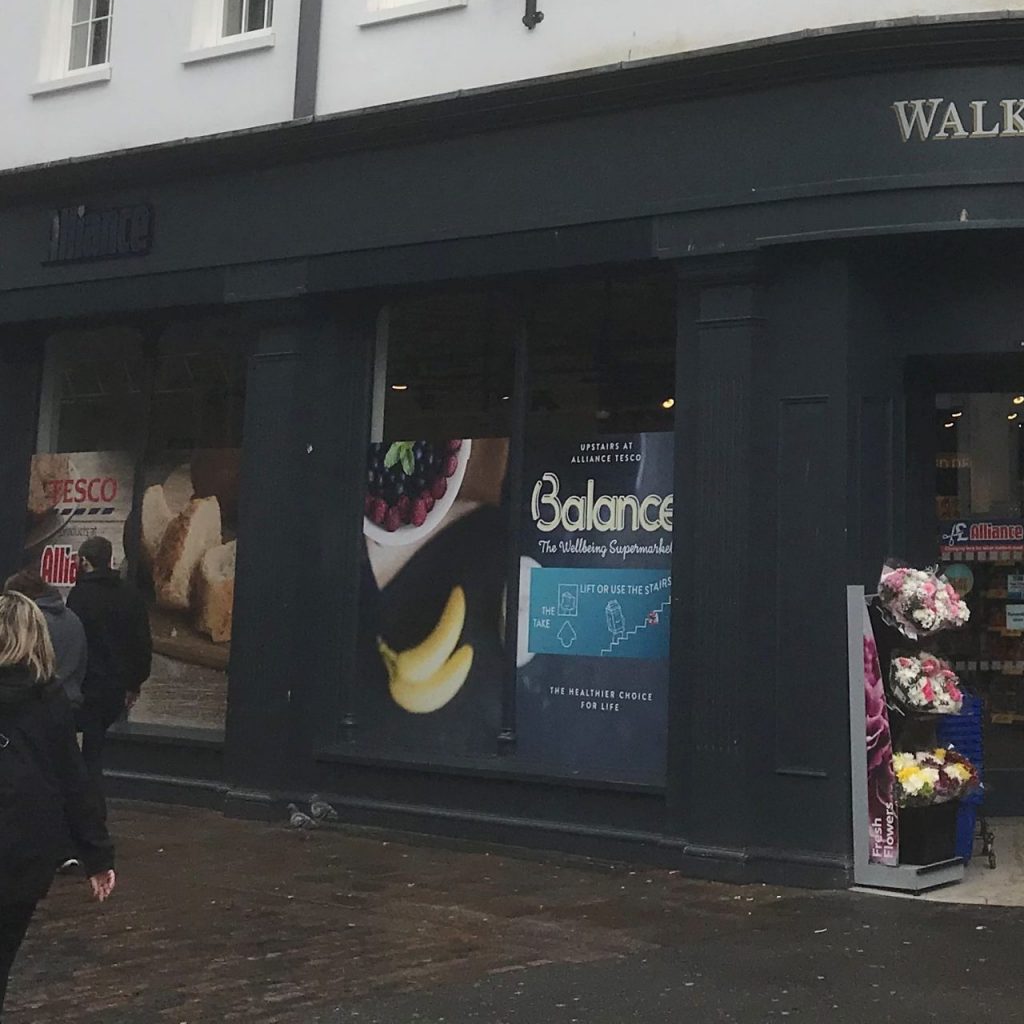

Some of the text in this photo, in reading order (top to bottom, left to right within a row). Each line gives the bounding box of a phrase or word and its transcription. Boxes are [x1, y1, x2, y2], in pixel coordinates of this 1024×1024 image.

[580, 441, 633, 451] UPSTAIRS AT
[571, 454, 642, 463] ALLIANCE TESCO
[47, 477, 118, 504] TESCO
[531, 472, 673, 532] Balance
[969, 522, 1024, 541] Alliance
[538, 539, 558, 554] The
[559, 537, 608, 558] Wellbeing
[580, 576, 672, 595] LIFT OR USE THE STAIRS
[541, 606, 556, 616] THE
[533, 618, 551, 629] TAKE
[550, 686, 653, 701] THE HEALTHIER CHOICE
[580, 701, 620, 712] FOR LIFE
[872, 817, 882, 857] Fresh
[884, 802, 894, 858] Flowers
